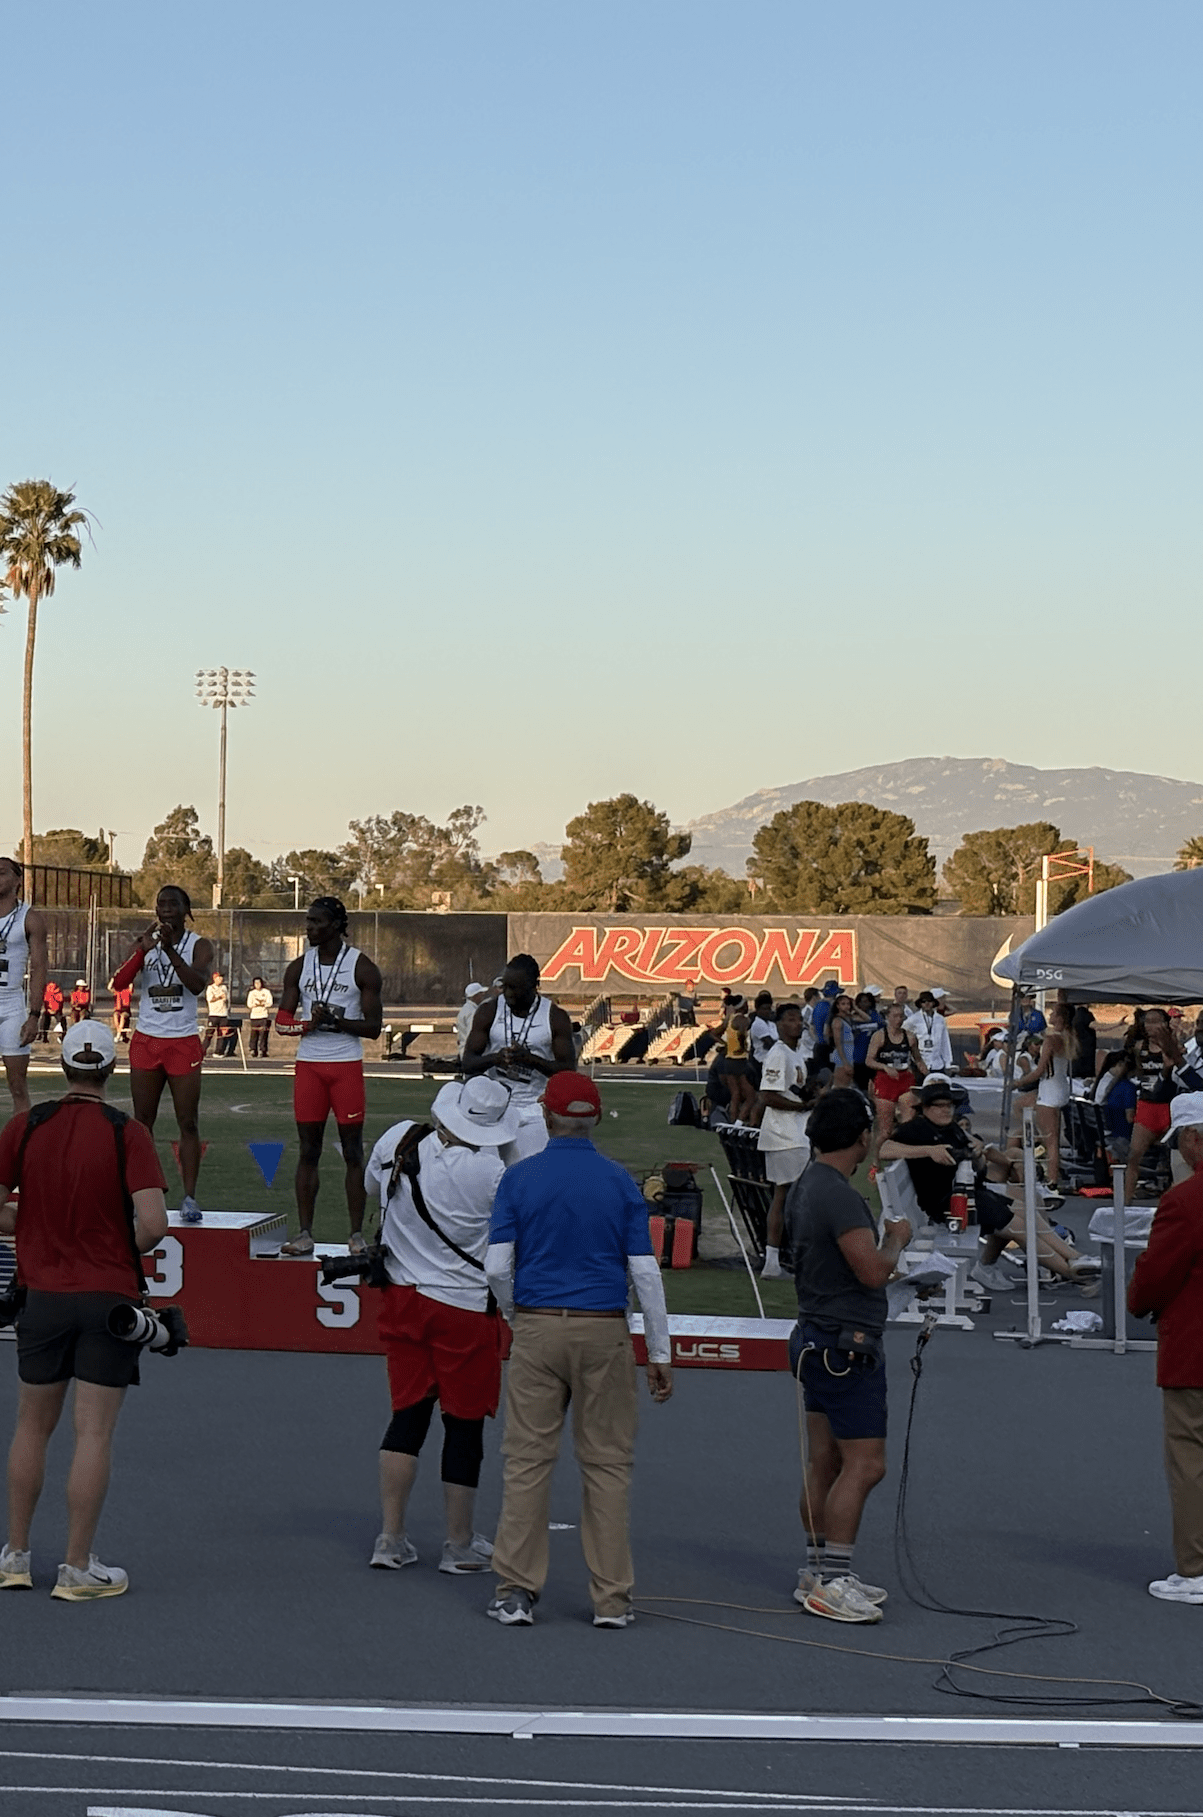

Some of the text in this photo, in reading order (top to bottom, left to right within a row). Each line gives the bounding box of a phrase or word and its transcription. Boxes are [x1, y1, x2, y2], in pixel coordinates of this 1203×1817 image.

[539, 927, 859, 985] ARIZONA
[1036, 968, 1063, 980] DSG
[948, 1220, 959, 1231] G
[142, 1235, 184, 1297] 3
[316, 1270, 360, 1329] 5
[676, 1343, 740, 1358] UCS
